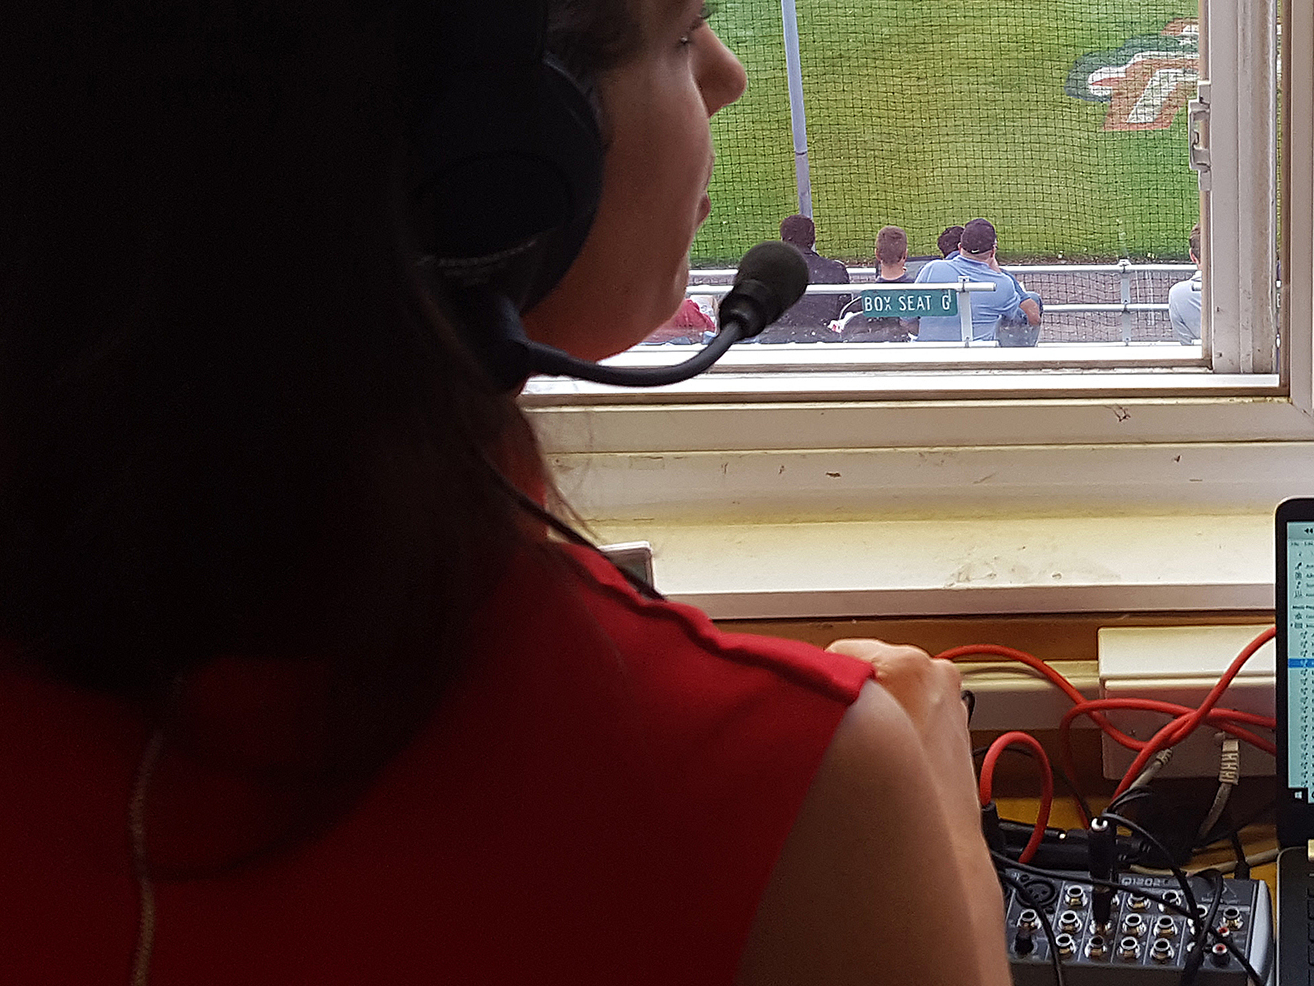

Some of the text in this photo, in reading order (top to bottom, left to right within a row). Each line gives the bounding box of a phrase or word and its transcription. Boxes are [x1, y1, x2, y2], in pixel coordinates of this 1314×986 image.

[864, 295, 951, 312] BOX SEAT G
[1121, 876, 1161, 887] Q1202
